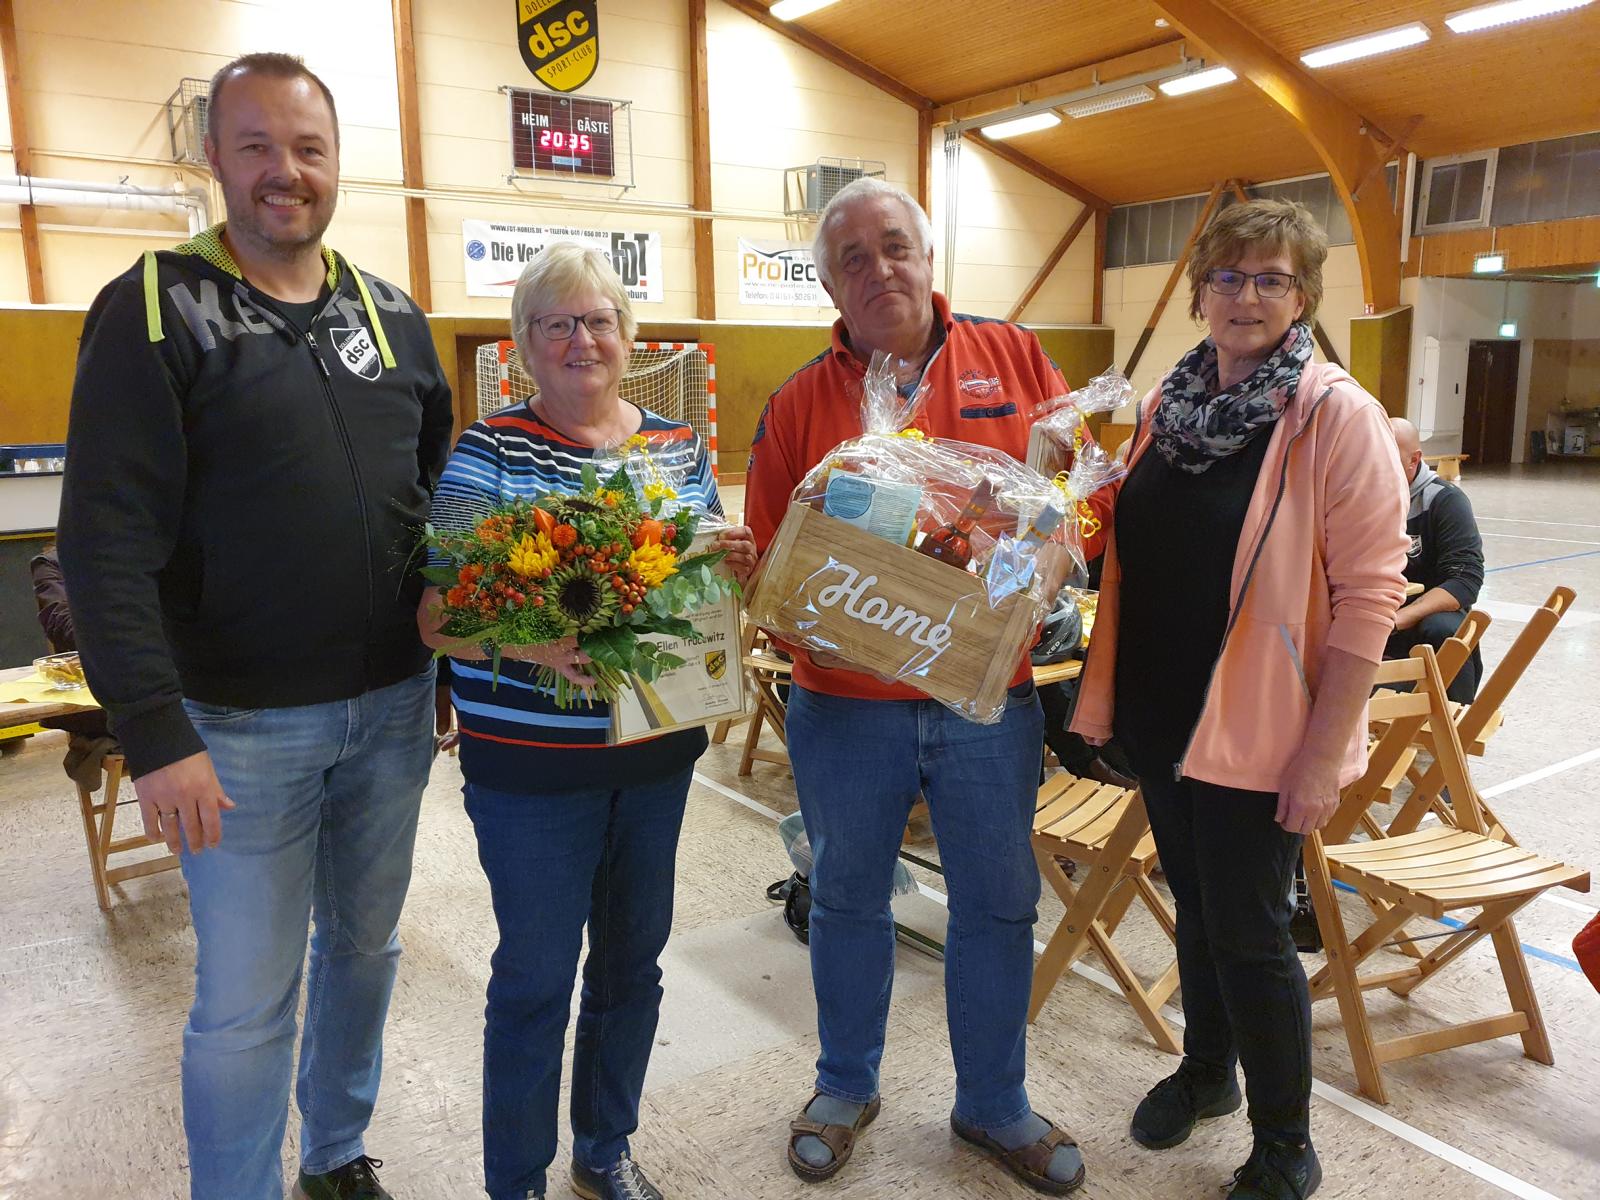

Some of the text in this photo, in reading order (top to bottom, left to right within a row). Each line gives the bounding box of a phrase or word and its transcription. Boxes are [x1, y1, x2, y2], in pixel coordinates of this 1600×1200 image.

[528, 10, 590, 60] dsc
[546, 44, 593, 79] SPORT-CLUB
[521, 112, 610, 135] HEIM GÄSTE
[540, 130, 590, 151] 20:35
[491, 241, 514, 262] Die
[743, 252, 817, 282] ProTec
[345, 338, 370, 365] dsc
[817, 562, 953, 648] Home
[656, 641, 679, 653] Ellen
